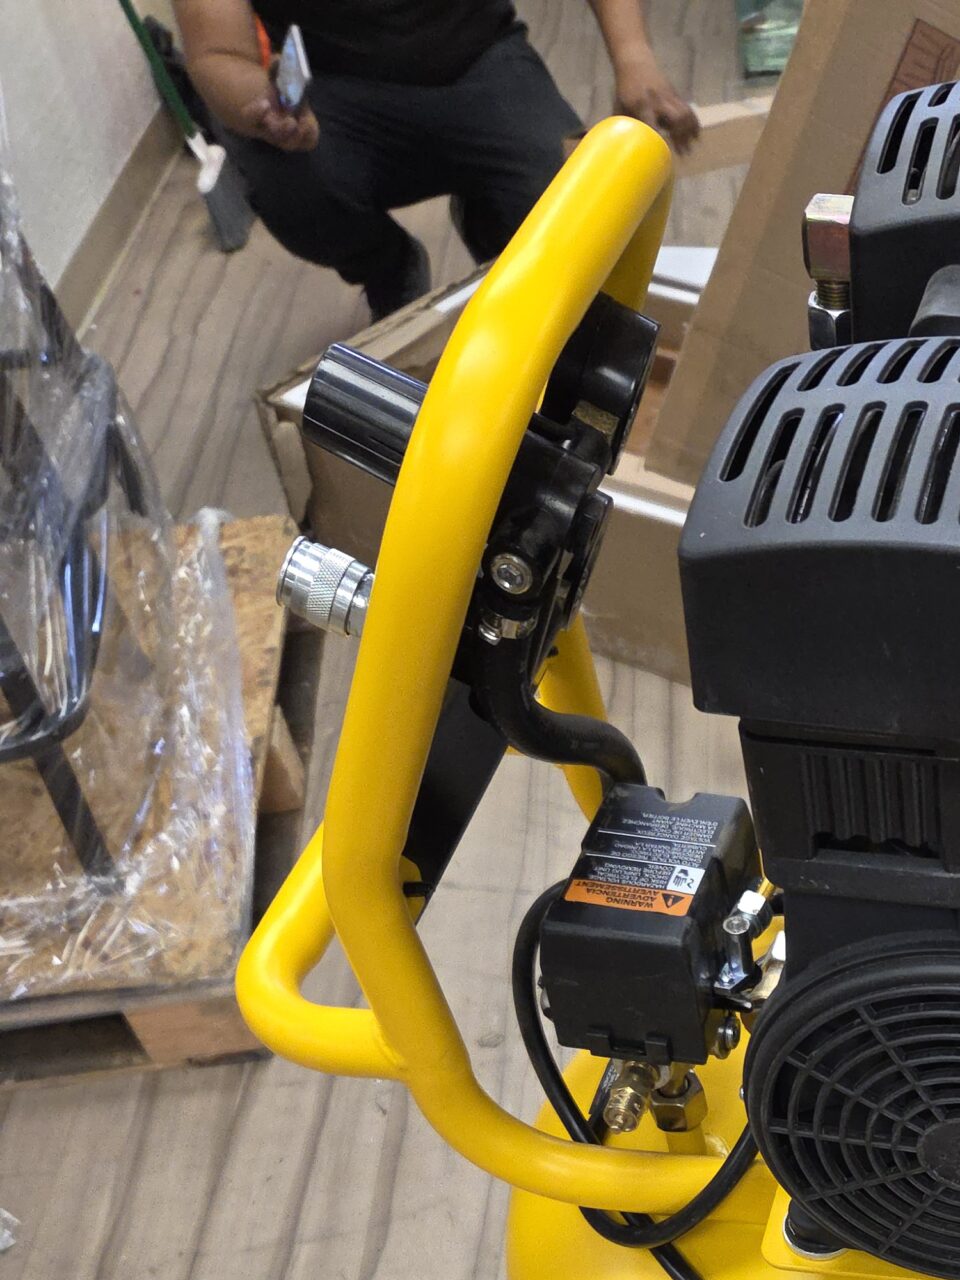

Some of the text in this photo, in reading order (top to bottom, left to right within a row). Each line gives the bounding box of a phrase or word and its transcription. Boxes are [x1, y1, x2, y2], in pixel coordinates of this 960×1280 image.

[605, 863, 641, 871] REMOVING
[597, 872, 637, 880] ELECTRICAL
[575, 880, 660, 896] AVERTISSEMENT
[621, 880, 665, 889] HAZARDOUS
[586, 888, 657, 902] ADVERTENCIA
[606, 897, 653, 908] WARNING
